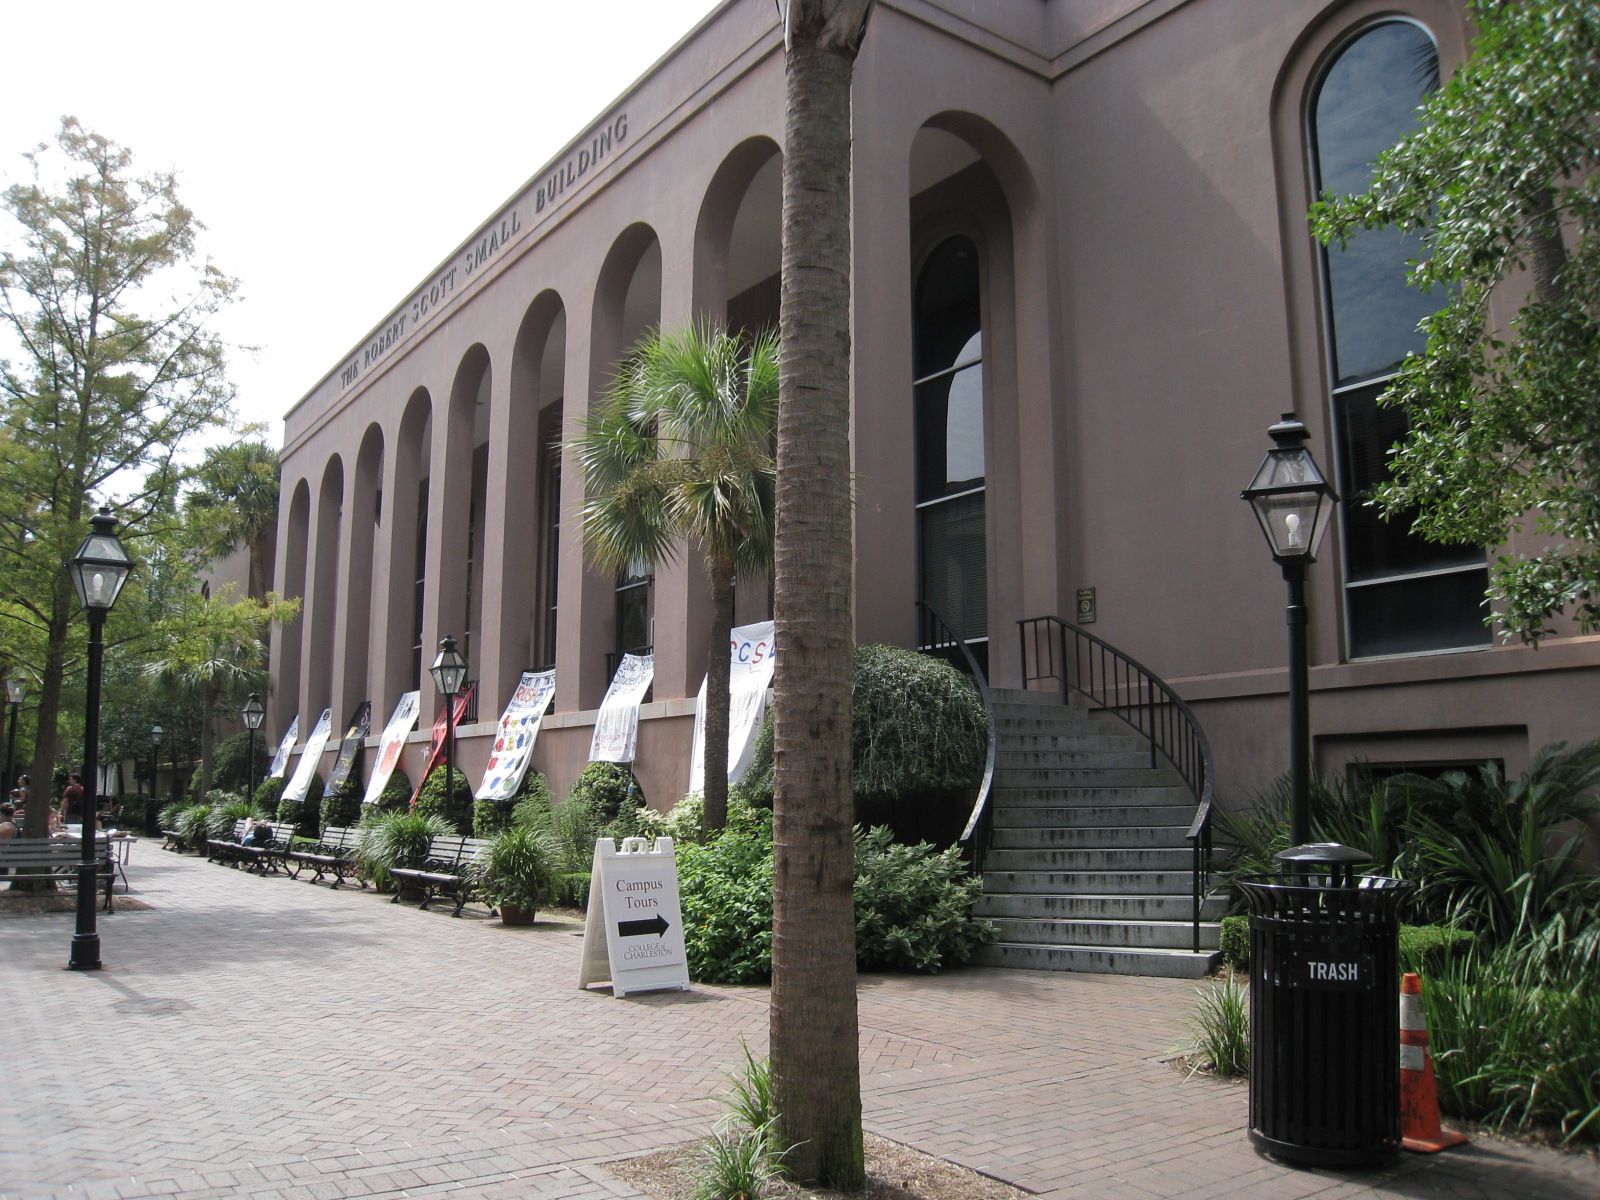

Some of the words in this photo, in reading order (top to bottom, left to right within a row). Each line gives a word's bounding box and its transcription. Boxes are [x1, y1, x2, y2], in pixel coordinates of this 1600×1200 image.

[341, 360, 359, 390] THE
[364, 313, 407, 369] ROBERT
[412, 266, 457, 323] SCOTT
[465, 211, 520, 275] SMALL
[535, 113, 628, 214] BUILDING
[616, 879, 663, 893] Campus
[625, 896, 659, 908] Tours
[624, 950, 673, 960] CHARLESTON
[1307, 961, 1358, 981] TRASH
